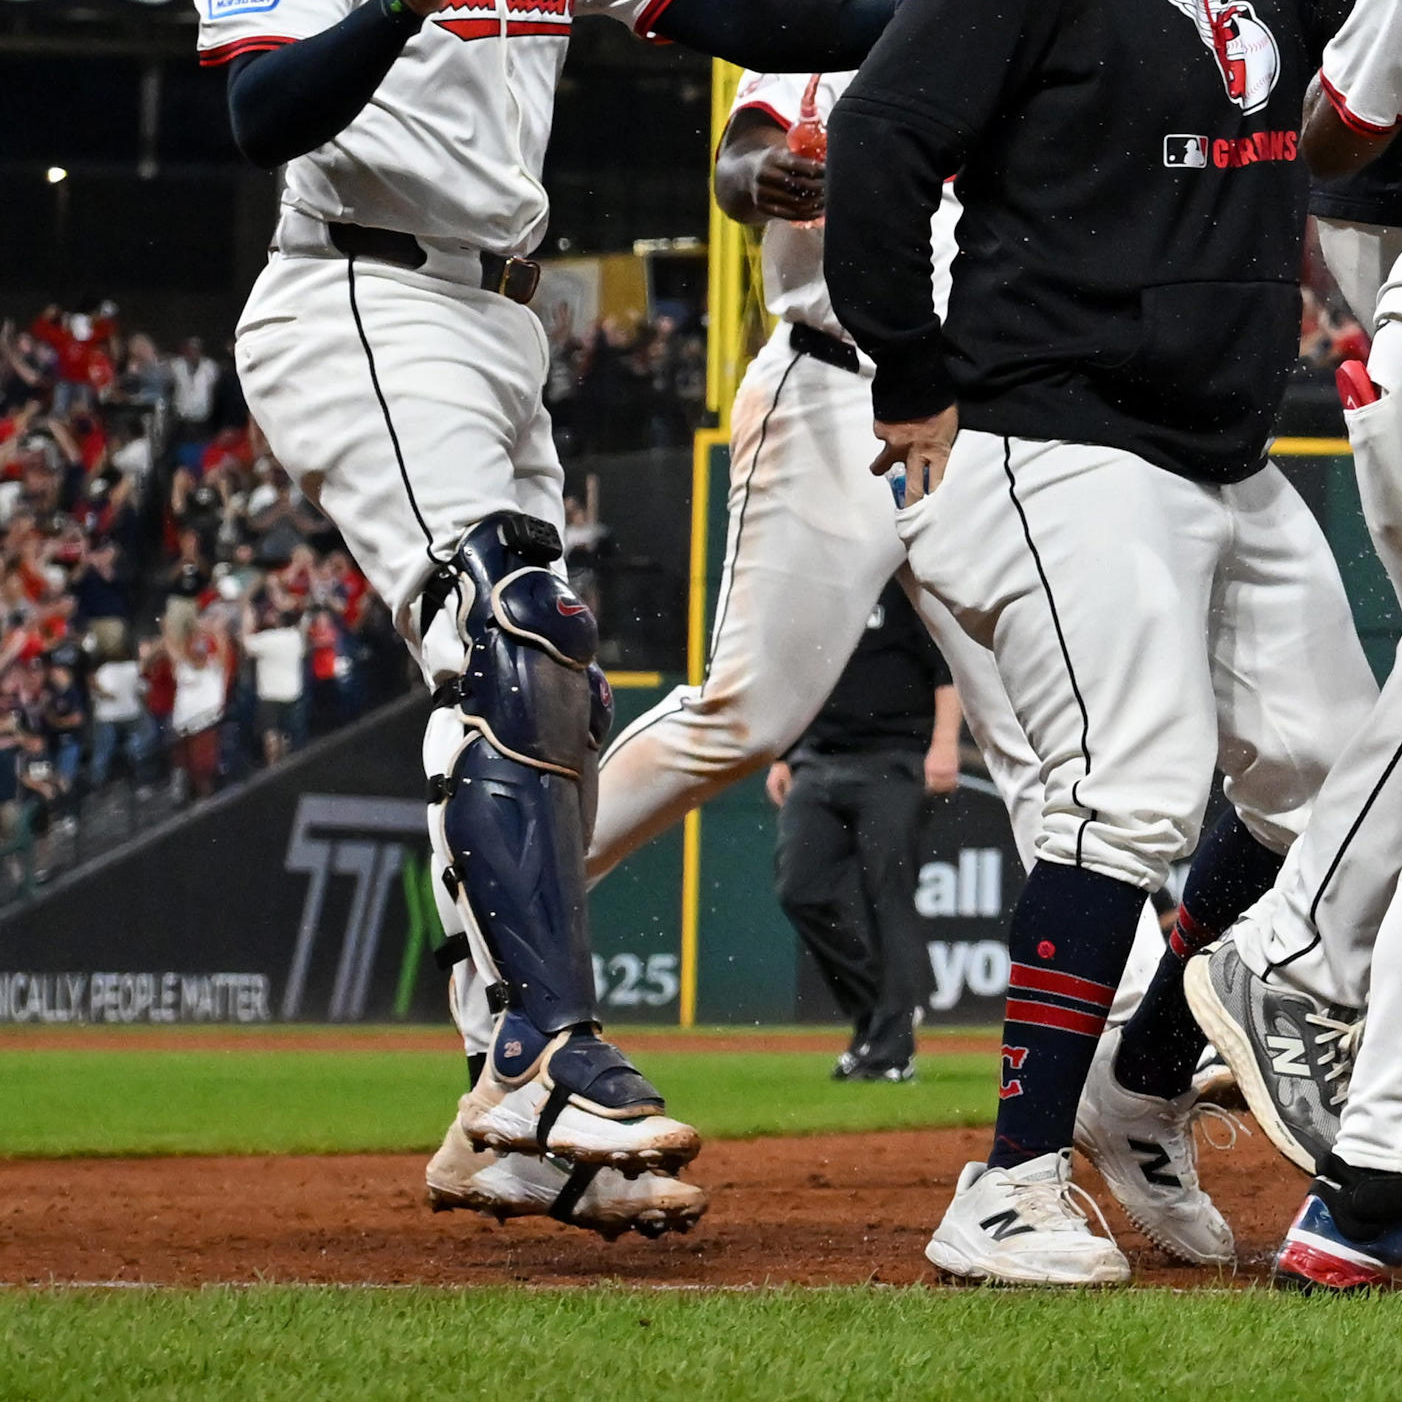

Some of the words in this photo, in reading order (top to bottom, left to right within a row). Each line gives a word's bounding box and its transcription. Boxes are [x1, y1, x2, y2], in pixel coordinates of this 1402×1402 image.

[915, 849, 1002, 919] all
[90, 972, 177, 1023] PEOPLE
[180, 972, 271, 1023] MATTER
[926, 939, 1008, 1011] yo
